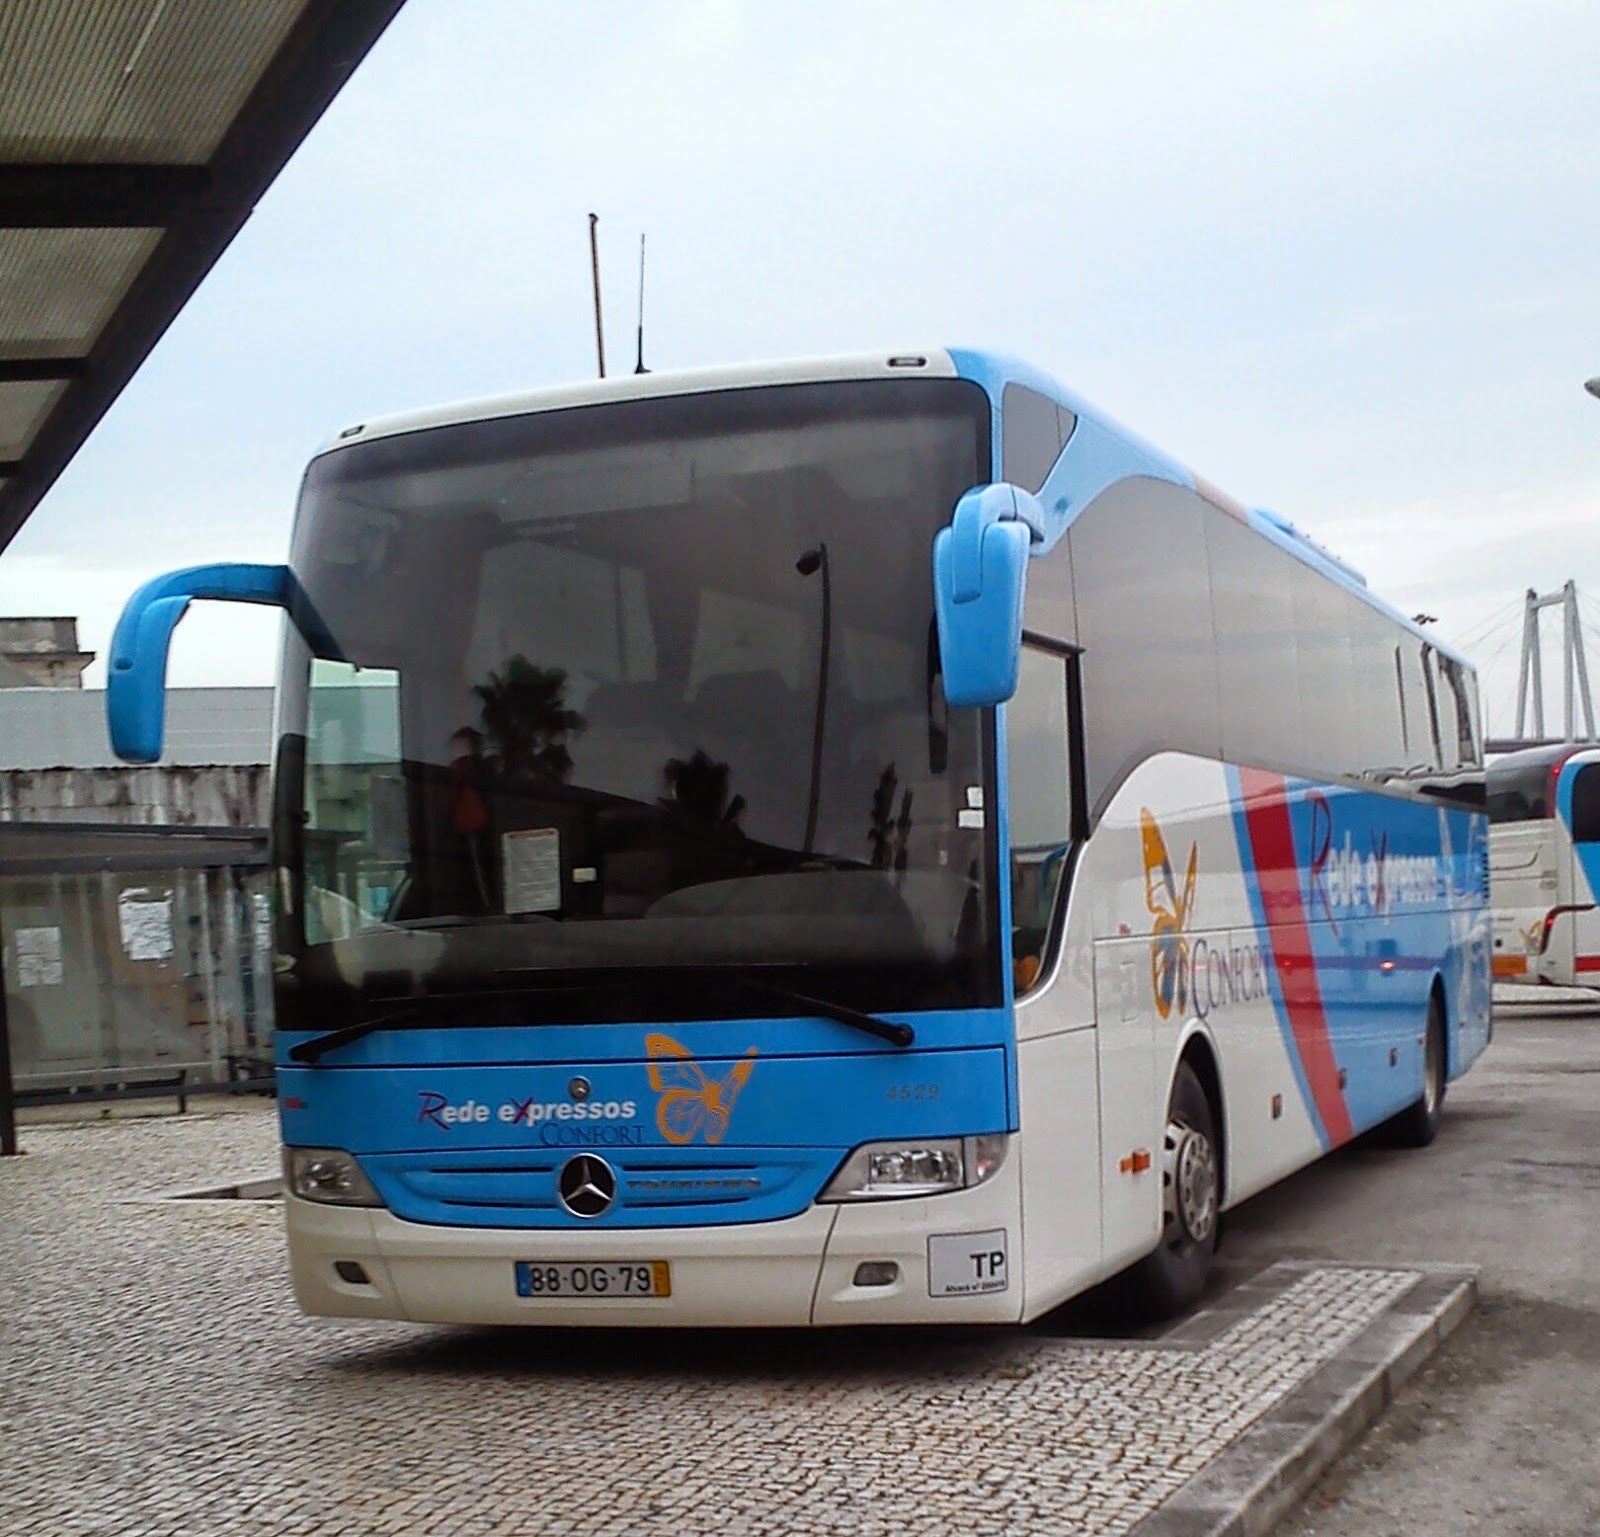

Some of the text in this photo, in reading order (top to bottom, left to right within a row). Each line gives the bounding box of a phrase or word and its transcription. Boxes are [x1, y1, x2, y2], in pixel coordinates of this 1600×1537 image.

[417, 1092, 490, 1131] Rede
[540, 1122, 645, 1146] CONFORT
[969, 1250, 1005, 1278] TP
